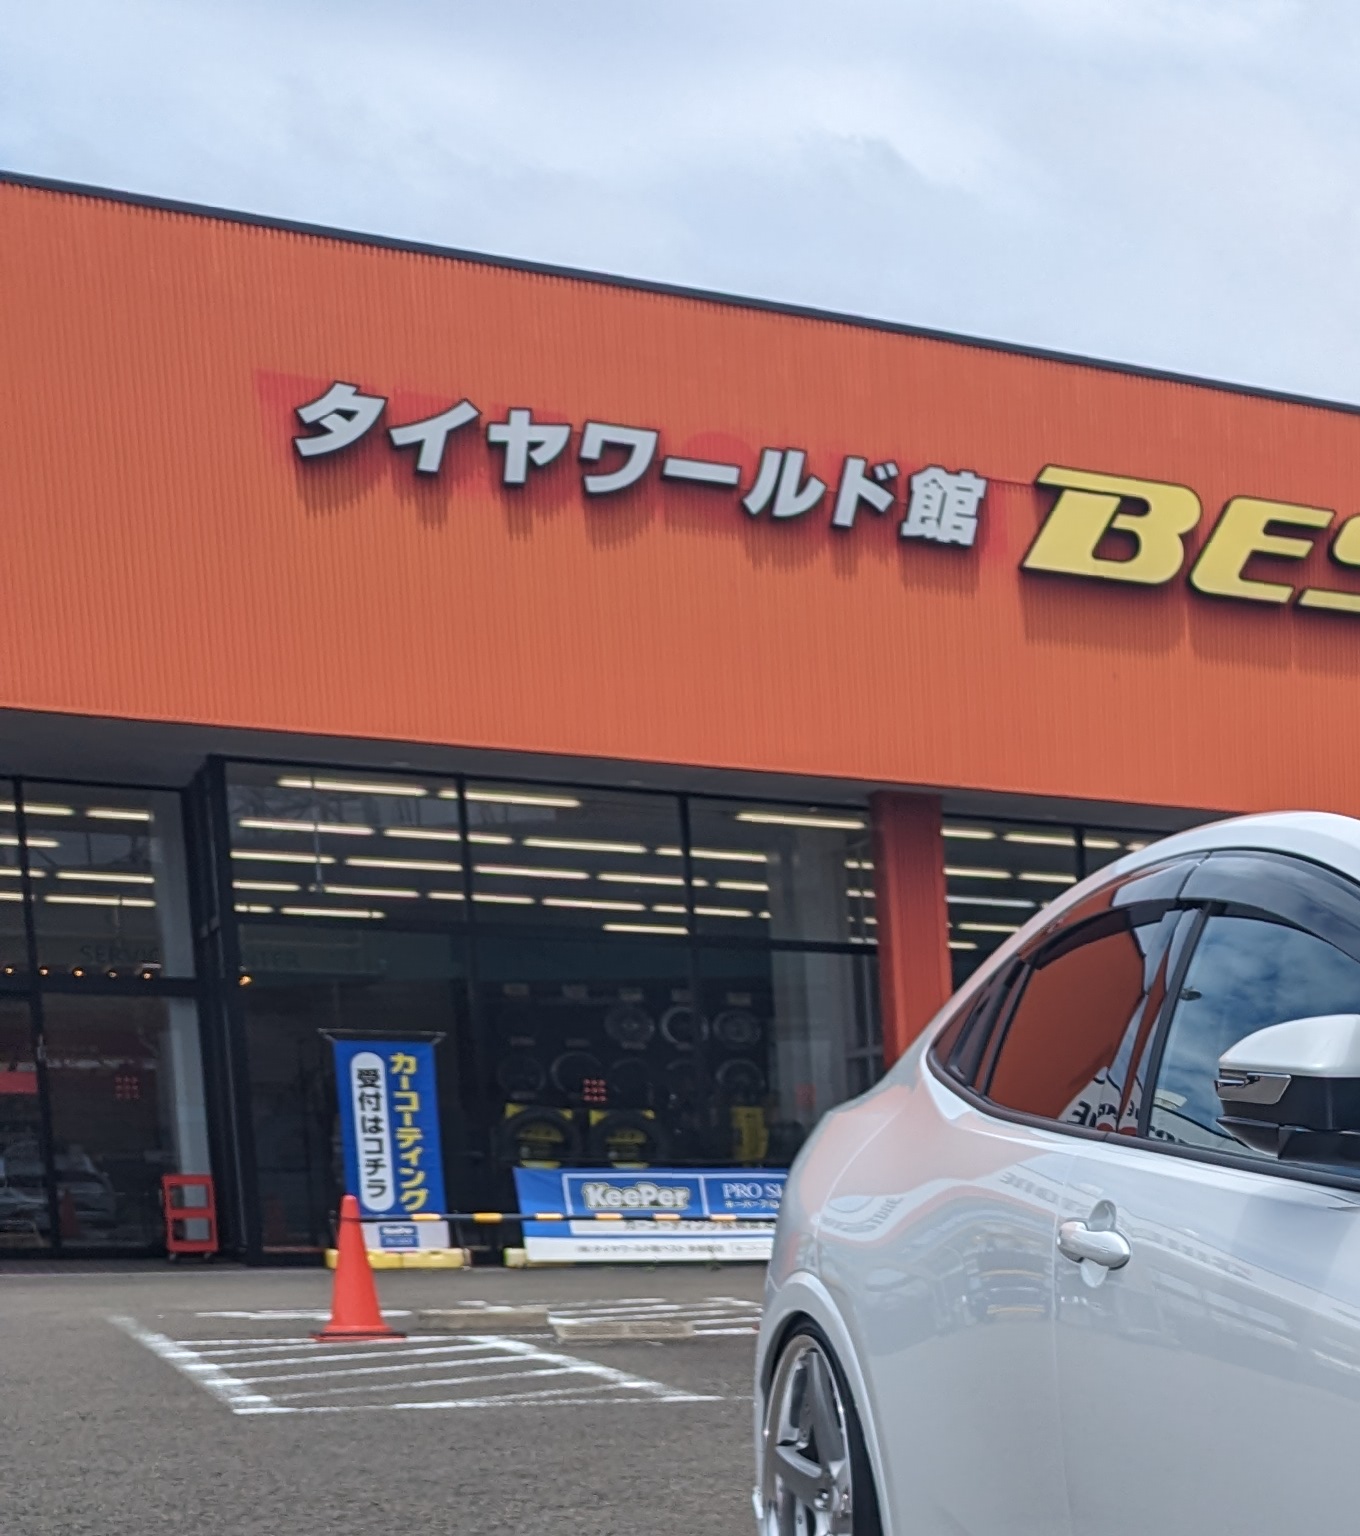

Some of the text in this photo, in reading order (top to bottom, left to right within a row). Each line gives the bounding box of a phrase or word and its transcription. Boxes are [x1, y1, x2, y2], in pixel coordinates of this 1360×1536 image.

[293, 380, 987, 548] タイヤワールド館
[356, 1068, 389, 1199] 受付はコチラ
[388, 1052, 430, 1212] カーコーティング
[582, 1181, 690, 1211] KeePer
[722, 1182, 763, 1200] PRO
